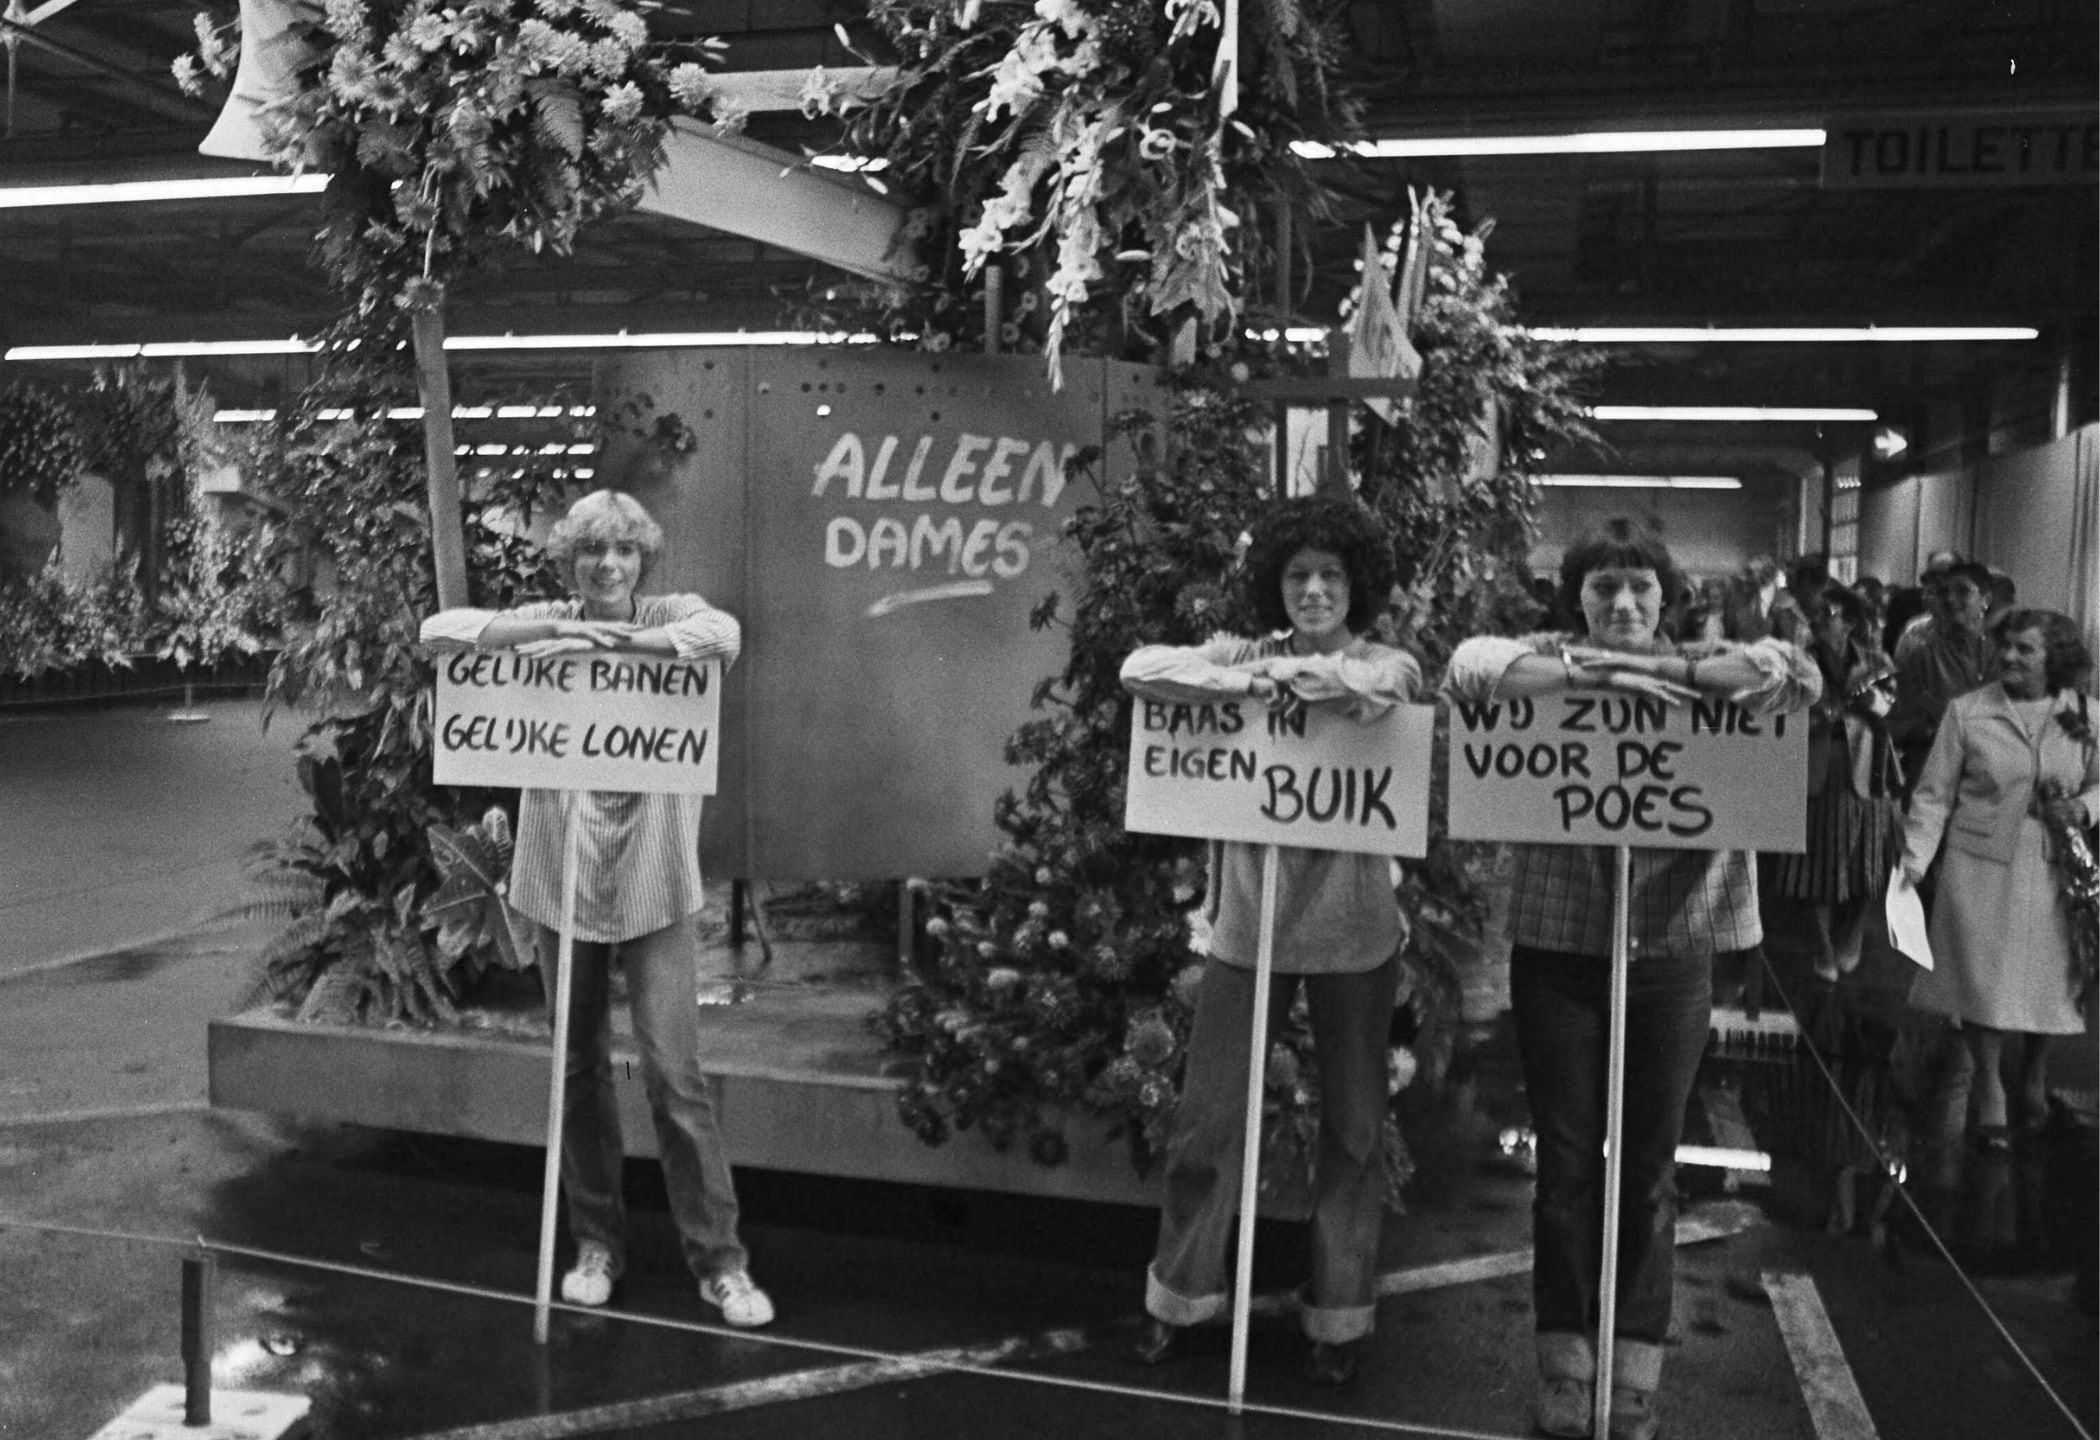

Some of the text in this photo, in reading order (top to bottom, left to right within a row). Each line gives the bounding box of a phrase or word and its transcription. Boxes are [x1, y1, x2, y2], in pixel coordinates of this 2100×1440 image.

[811, 432, 1076, 507] ALLEEN
[824, 514, 1033, 578] DAMES
[590, 659, 708, 697] BANEN
[442, 714, 709, 766] GELIJKE LONEN
[1144, 700, 1245, 736] BAAS
[1144, 744, 1257, 782] EIGEN
[1464, 740, 1683, 781] VOOR DE
[1260, 764, 1397, 831] BUIK
[1552, 784, 1714, 838] POES
